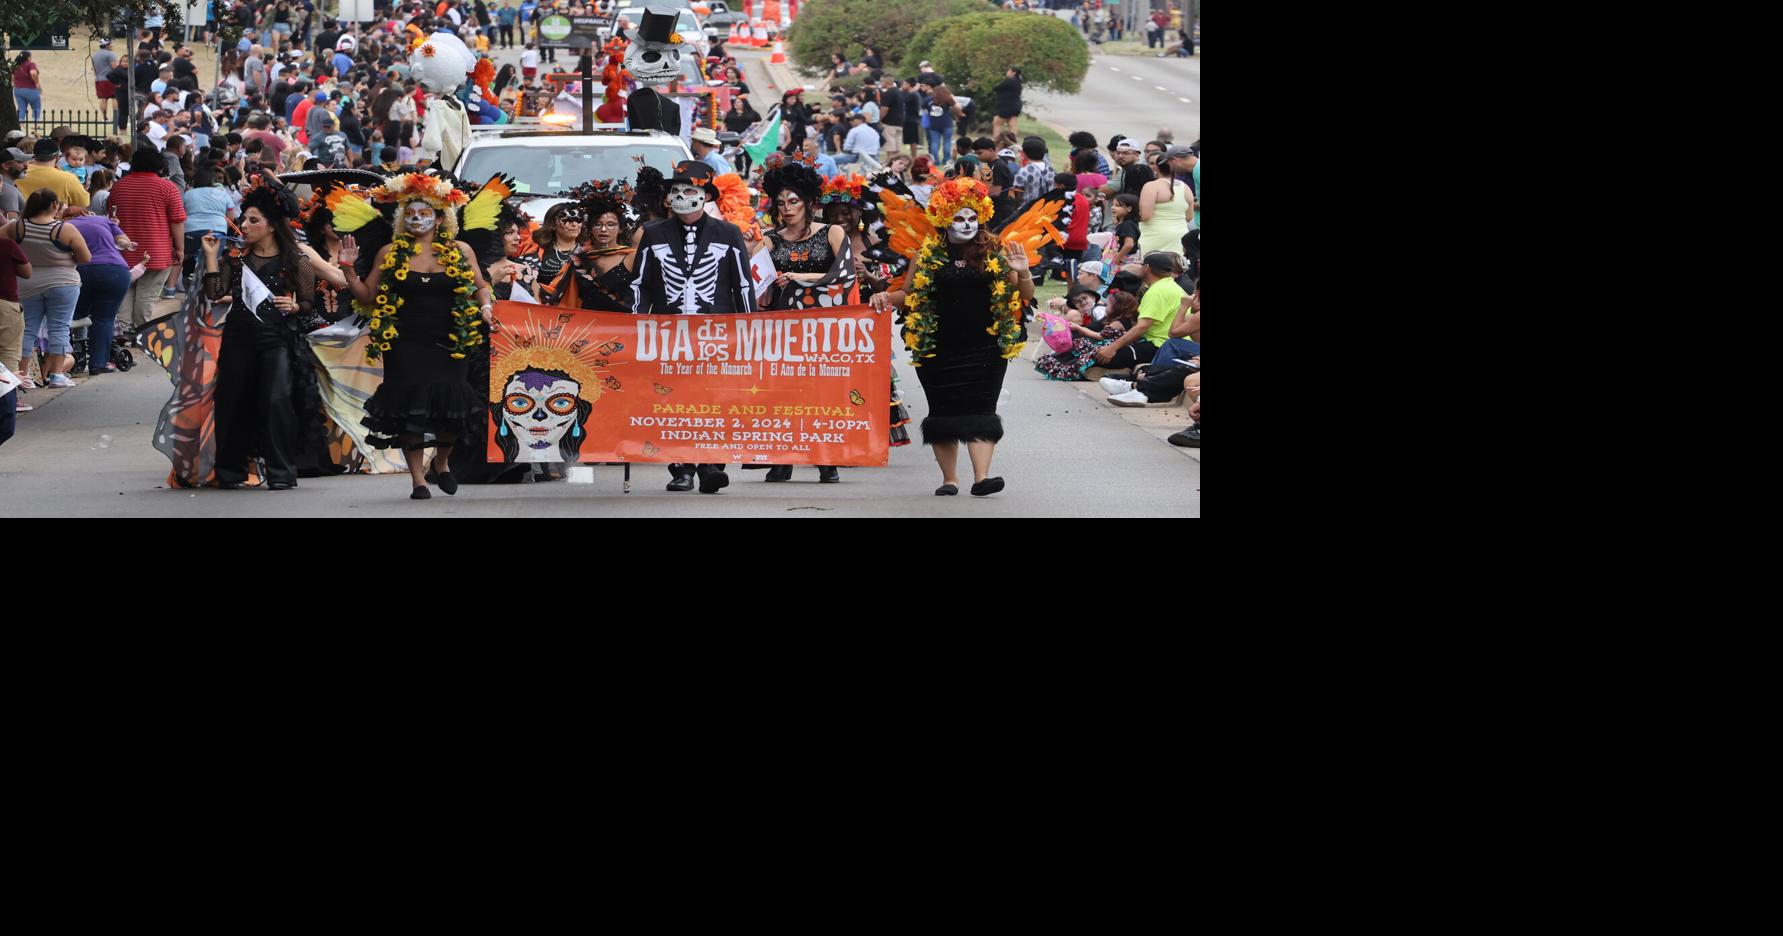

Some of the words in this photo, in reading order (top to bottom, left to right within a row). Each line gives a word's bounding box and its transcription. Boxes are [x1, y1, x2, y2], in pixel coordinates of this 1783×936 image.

[735, 318, 875, 361] MUERTOS
[804, 354, 853, 363] WACO,
[855, 354, 876, 363] TX
[660, 362, 673, 375] The
[676, 362, 693, 375] Year
[696, 362, 704, 375] of
[706, 362, 718, 375] the
[720, 362, 752, 376] Monarch
[770, 362, 778, 376] El
[797, 363, 807, 377] de
[809, 363, 817, 377] la
[819, 363, 851, 377] Monarca
[652, 403, 721, 414] PARADE
[728, 405, 767, 415] AND
[773, 406, 855, 417] FESTIVAL
[630, 416, 725, 428] NOVEMBER
[732, 418, 745, 429] 2,
[751, 418, 792, 429] 2024
[812, 419, 871, 431] 4-10PM
[660, 430, 726, 441] INDIAN
[732, 431, 793, 442] SPRING
[800, 432, 845, 443] PARK
